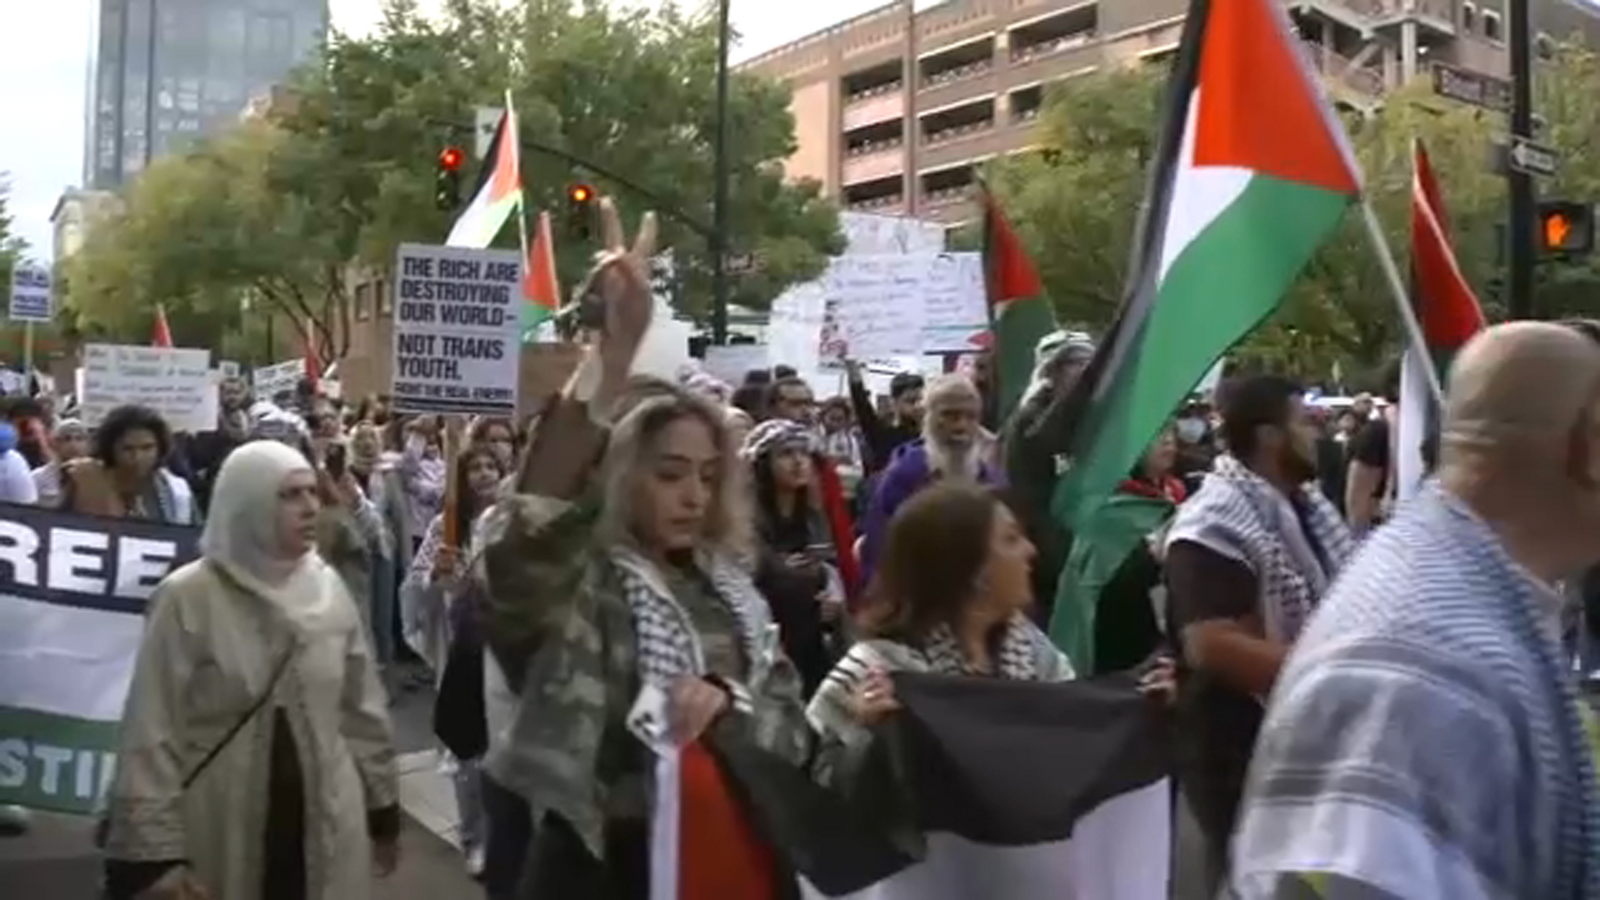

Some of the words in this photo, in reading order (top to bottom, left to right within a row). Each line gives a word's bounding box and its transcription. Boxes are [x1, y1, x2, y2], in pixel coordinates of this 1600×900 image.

[402, 257, 433, 278] THE
[439, 259, 481, 281] RICH
[484, 263, 519, 283] ARE
[400, 280, 511, 304] DESTROYING
[400, 302, 436, 322] OUR
[398, 333, 436, 356] NOT
[440, 336, 505, 360] TRANS
[397, 357, 462, 380] YOUTH.
